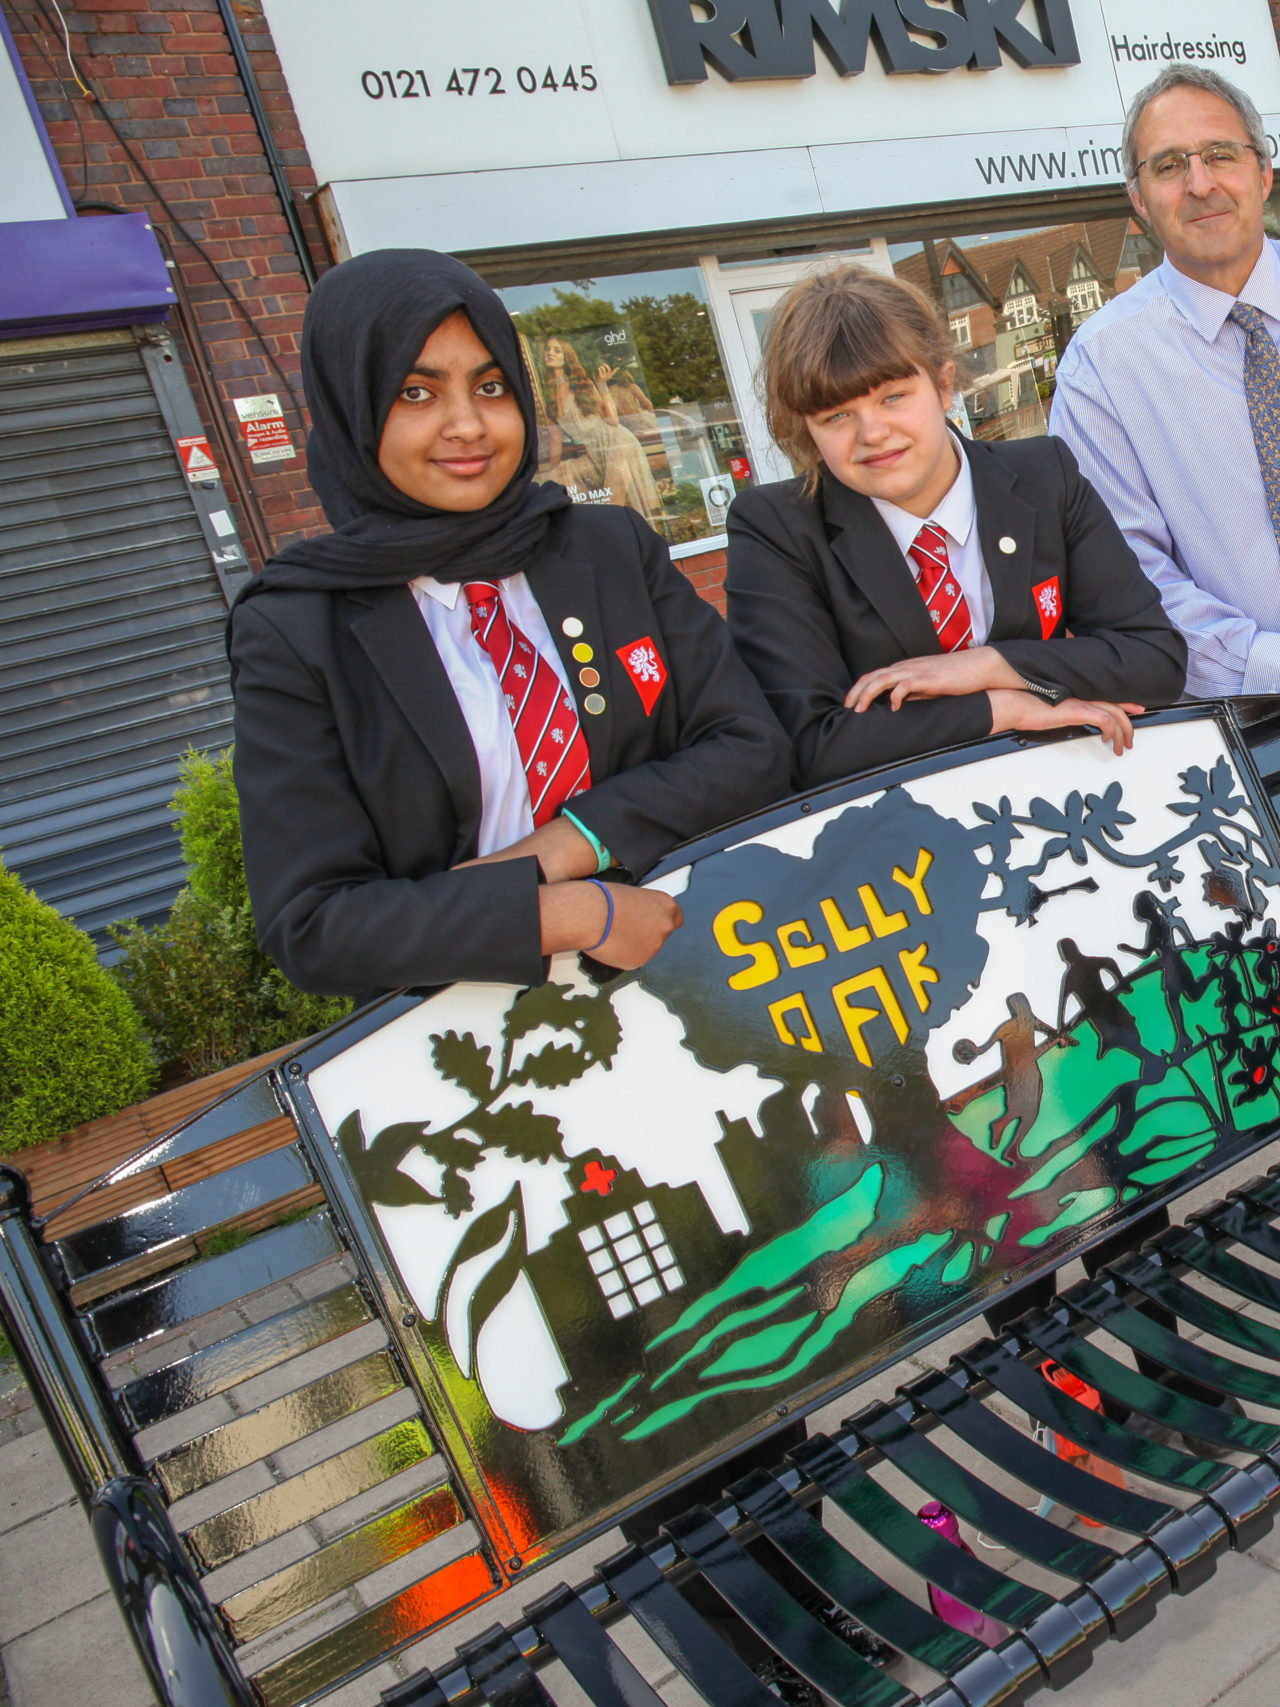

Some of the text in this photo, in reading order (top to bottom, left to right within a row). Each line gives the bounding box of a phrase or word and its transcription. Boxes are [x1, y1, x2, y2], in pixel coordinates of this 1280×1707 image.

[648, 0, 1081, 86] RIMSKI
[1111, 31, 1246, 65] Hairdressing
[361, 64, 598, 100] 0121 472 0445
[604, 328, 626, 346] ghd
[241, 409, 279, 419] verisure
[246, 420, 285, 433] Alarm
[588, 486, 613, 500] MAX
[767, 941, 940, 1068] OAK
